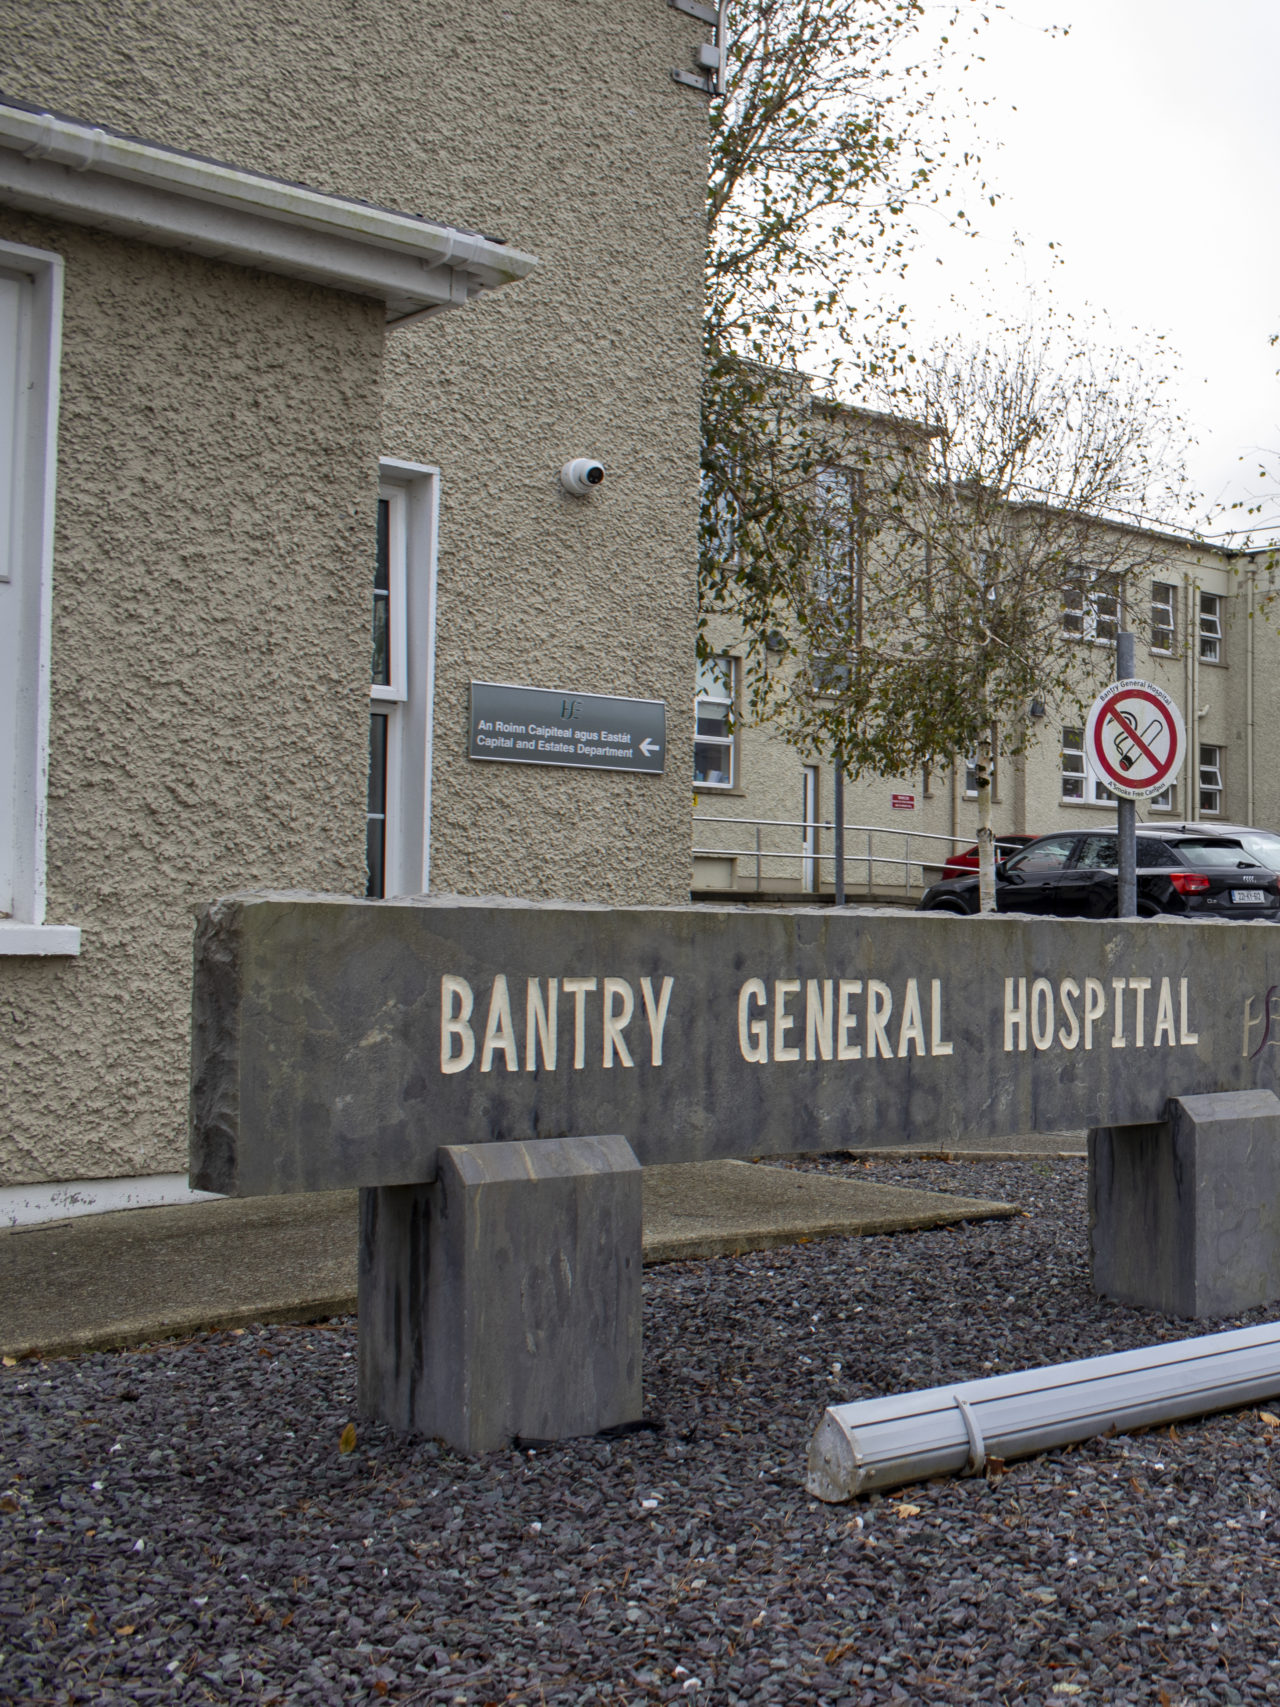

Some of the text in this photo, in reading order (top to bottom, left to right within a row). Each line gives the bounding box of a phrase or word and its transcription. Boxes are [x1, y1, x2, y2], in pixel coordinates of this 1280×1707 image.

[1100, 680, 1172, 706] Bantry General Hospital
[478, 720, 631, 744] An Roinn Caipiteal agus Eastát
[477, 735, 633, 758] Capital and Estates Department
[440, 974, 1199, 1074] BANTRY GENERAL HOSPITAL
